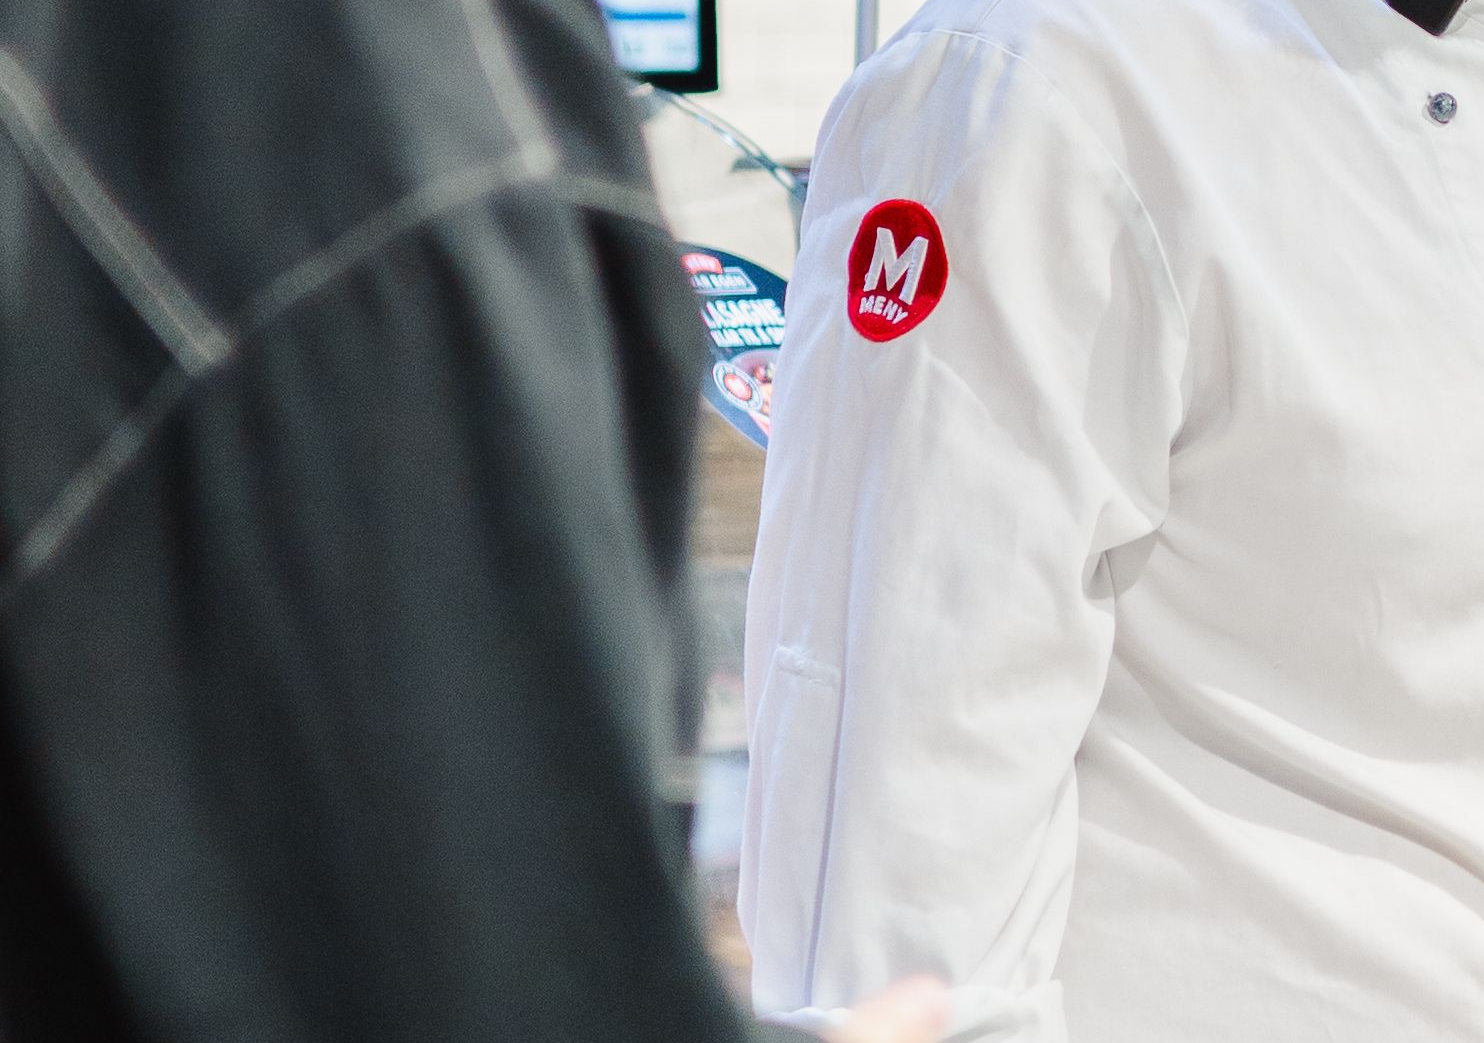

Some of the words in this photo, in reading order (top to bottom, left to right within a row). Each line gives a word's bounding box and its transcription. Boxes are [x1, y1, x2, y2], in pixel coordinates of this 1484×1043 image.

[863, 226, 929, 306] M
[701, 298, 785, 329] LASAGNE
[859, 295, 909, 325] MENY
